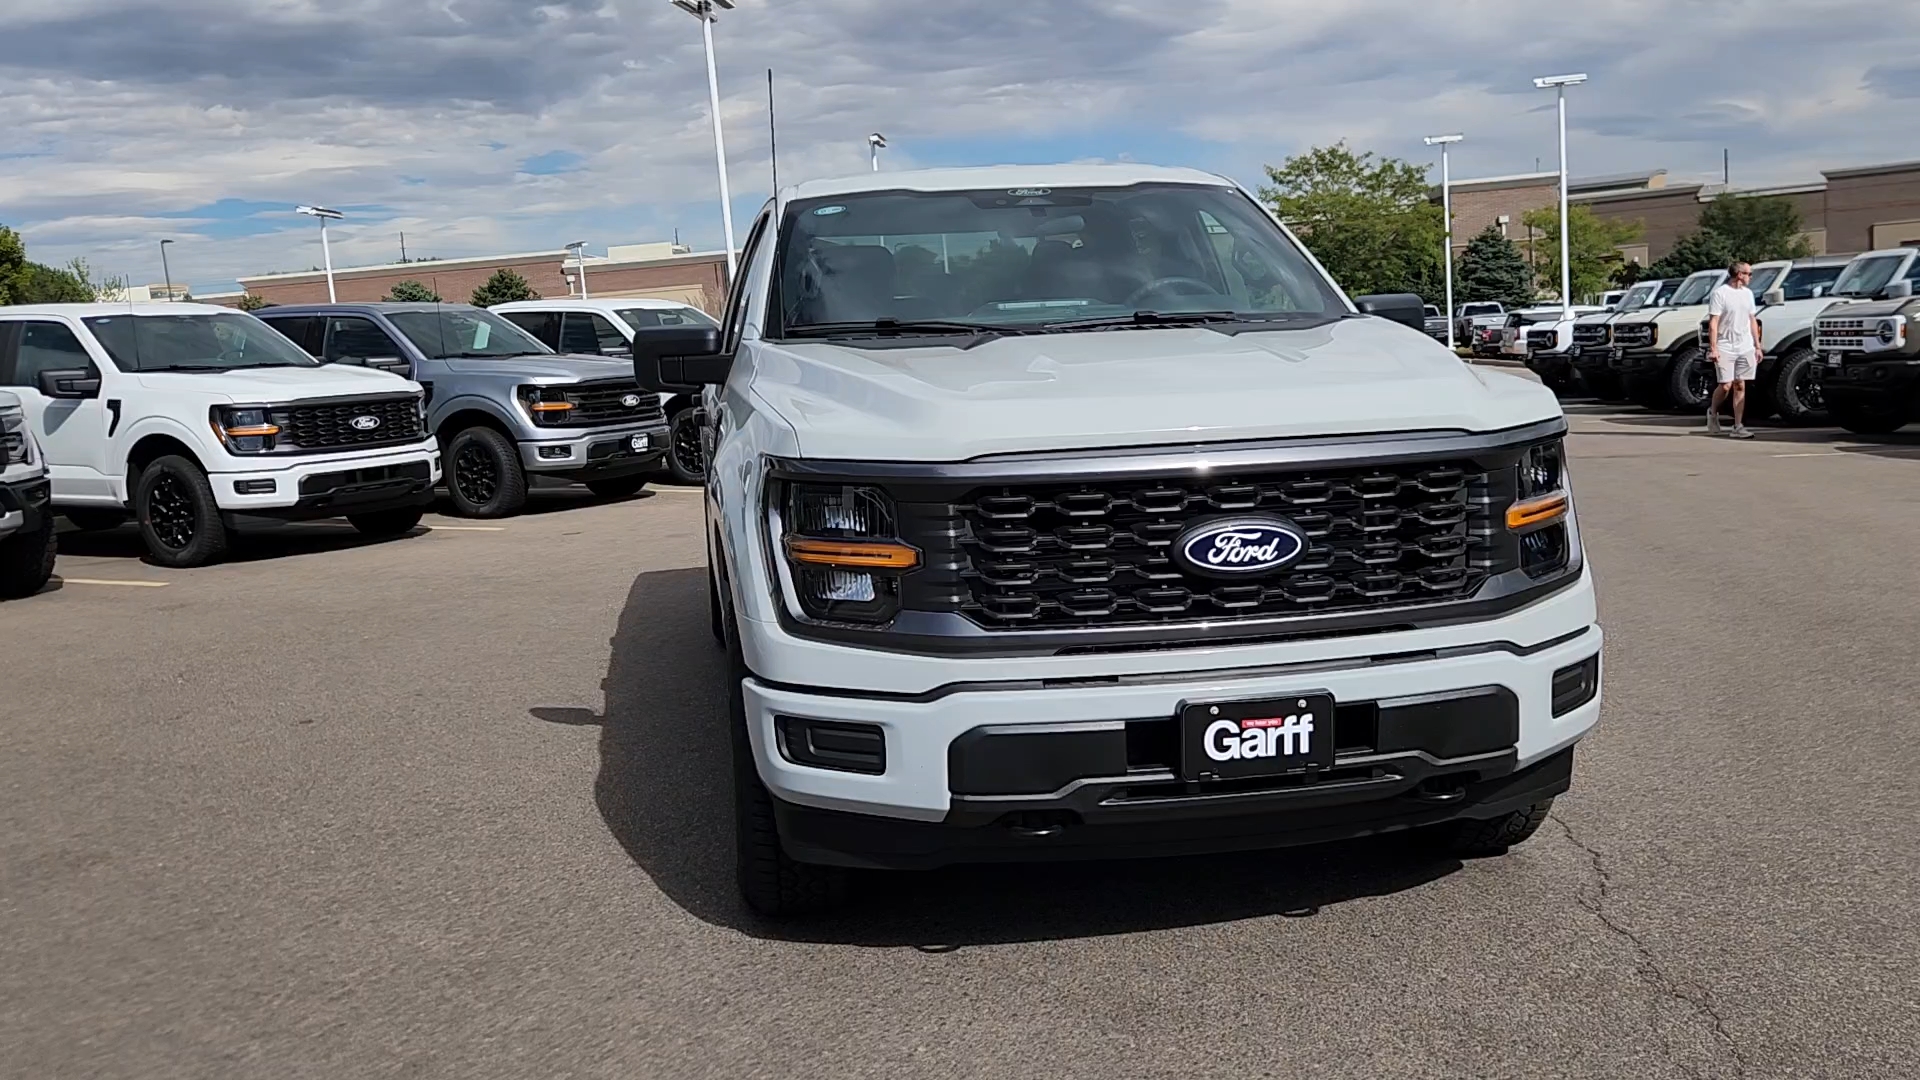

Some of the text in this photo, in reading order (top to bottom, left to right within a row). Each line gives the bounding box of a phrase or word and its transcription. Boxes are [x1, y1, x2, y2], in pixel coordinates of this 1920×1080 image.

[1016, 187, 1043, 196] Ford
[357, 416, 375, 428] Ford
[1207, 532, 1280, 564] Ford
[1203, 713, 1314, 761] Garff
